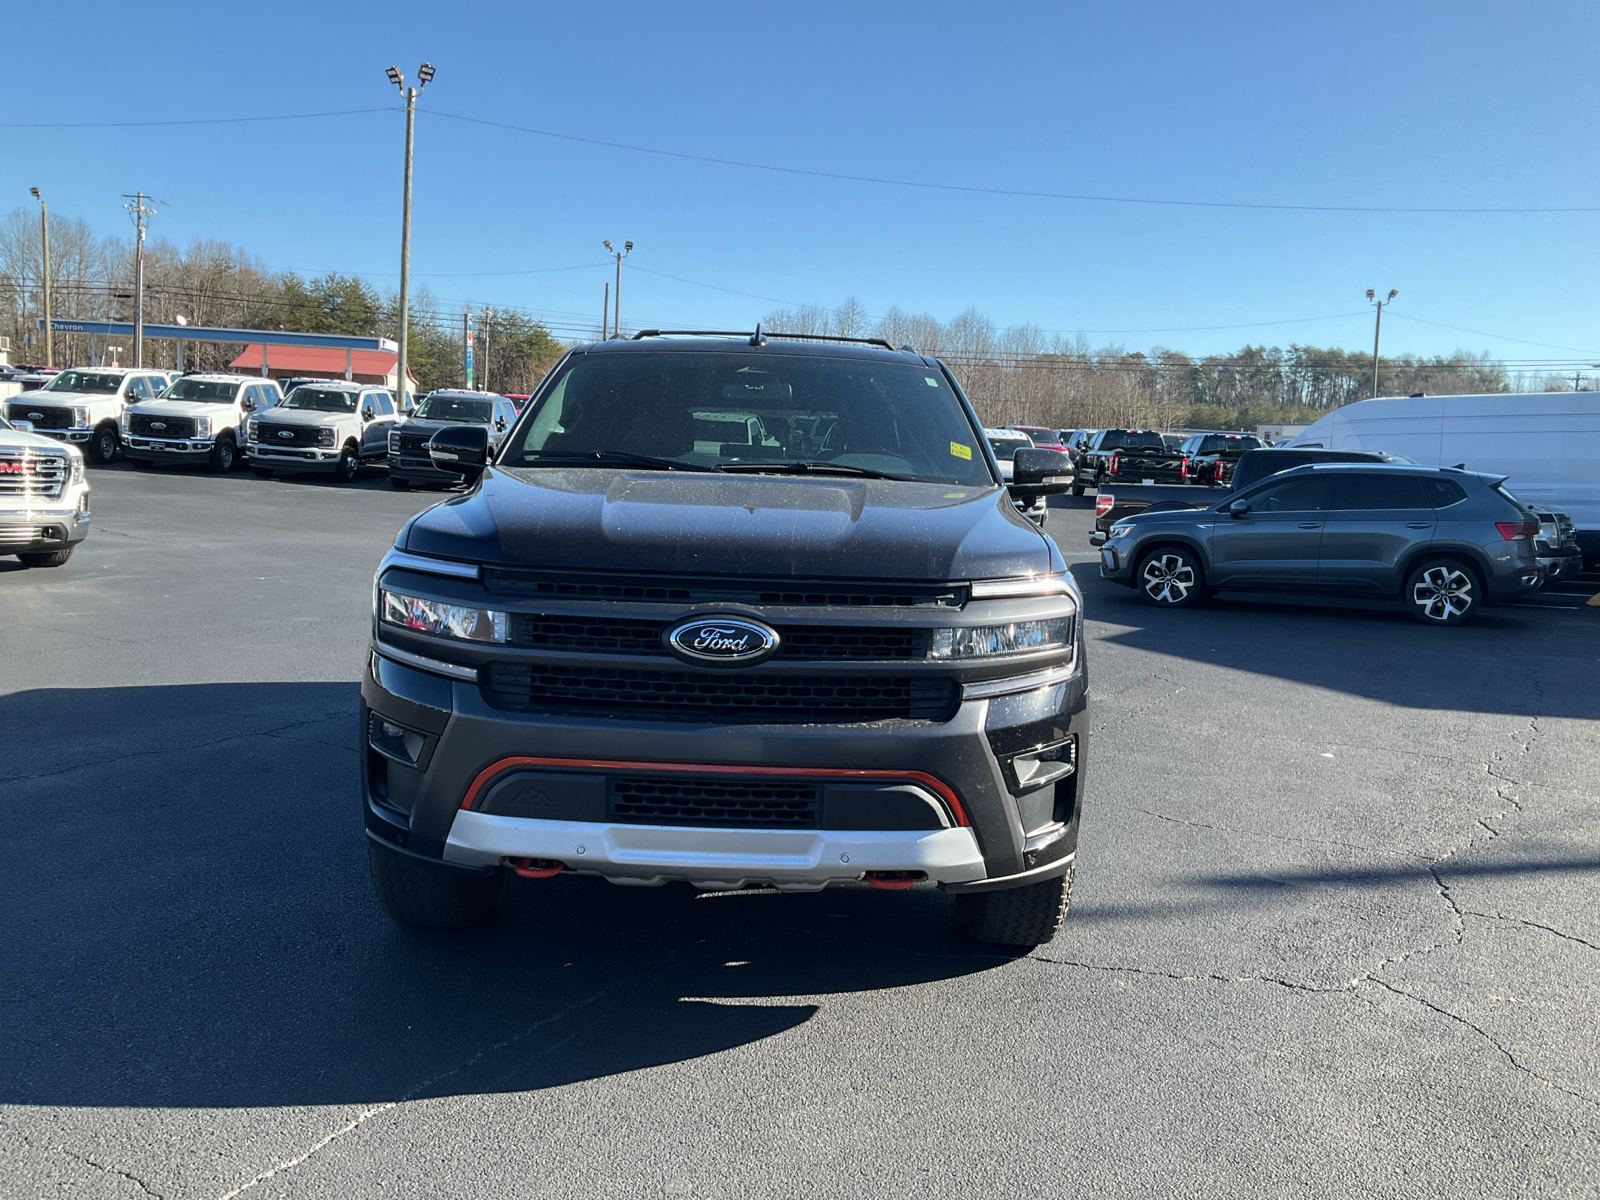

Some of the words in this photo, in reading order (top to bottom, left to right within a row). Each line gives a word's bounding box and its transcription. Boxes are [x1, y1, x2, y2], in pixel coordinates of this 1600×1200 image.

[50, 322, 83, 331] Chevron
[0, 462, 35, 473] MC
[694, 627, 749, 650] Ford
